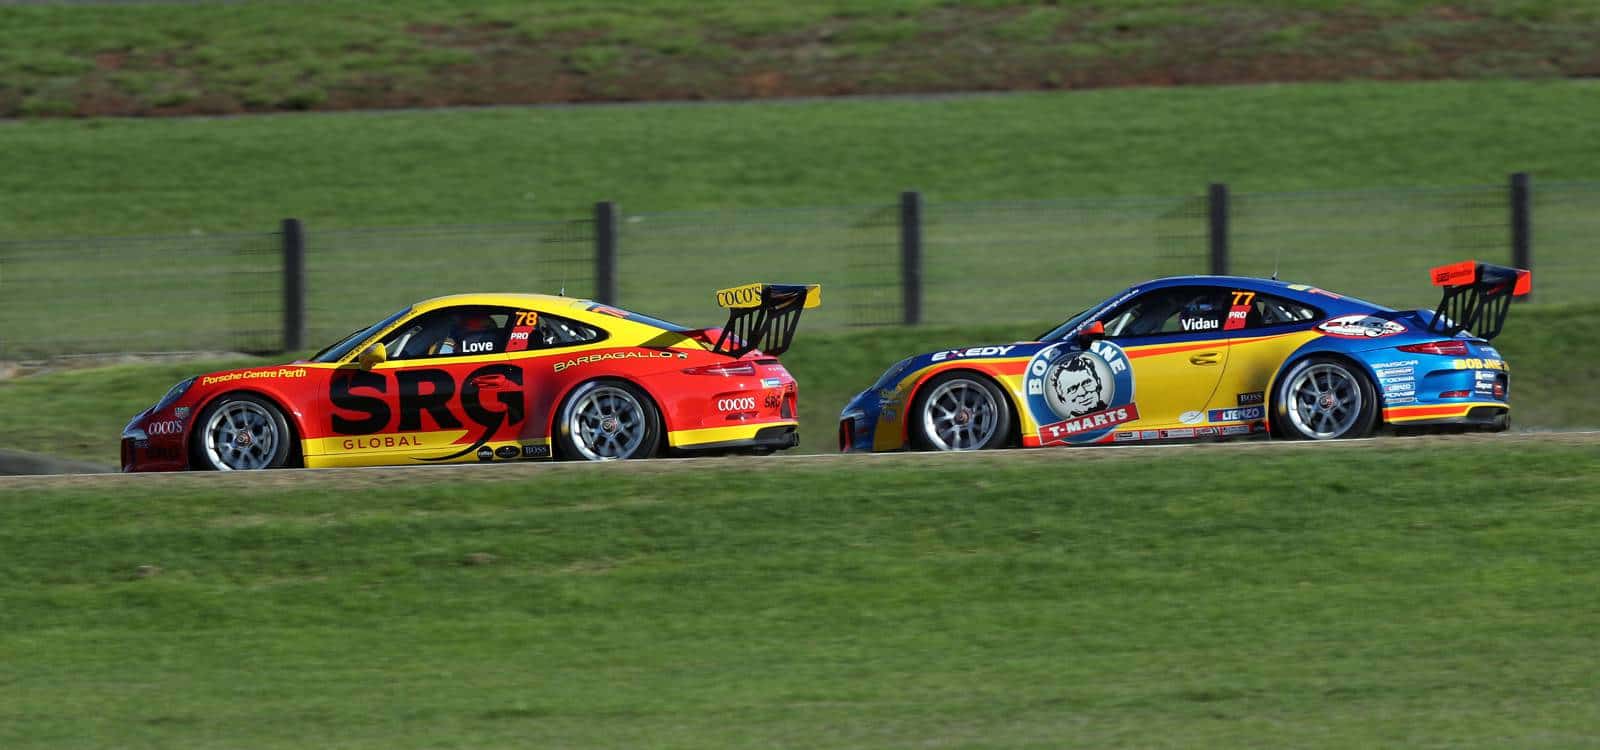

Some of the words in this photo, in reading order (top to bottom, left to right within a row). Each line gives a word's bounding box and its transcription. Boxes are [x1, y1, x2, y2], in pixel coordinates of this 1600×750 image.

[717, 285, 761, 308] COCO'S
[1232, 291, 1255, 305] 77
[515, 311, 538, 326] 78
[1228, 311, 1247, 319] PRO
[1181, 318, 1219, 331] Vidau
[510, 332, 529, 340] PRO
[462, 340, 493, 353] Love
[931, 345, 1016, 362] EXEDY
[553, 352, 673, 373] BARBAGALLO
[202, 373, 242, 385] Porsche
[243, 370, 276, 379] Centre
[278, 368, 306, 378] Perth
[718, 397, 756, 411] COCO'S
[329, 364, 525, 461] SRG
[149, 420, 183, 434] COCO'S
[1049, 408, 1128, 437] T-MARTS
[343, 436, 423, 450] GLOBAL
